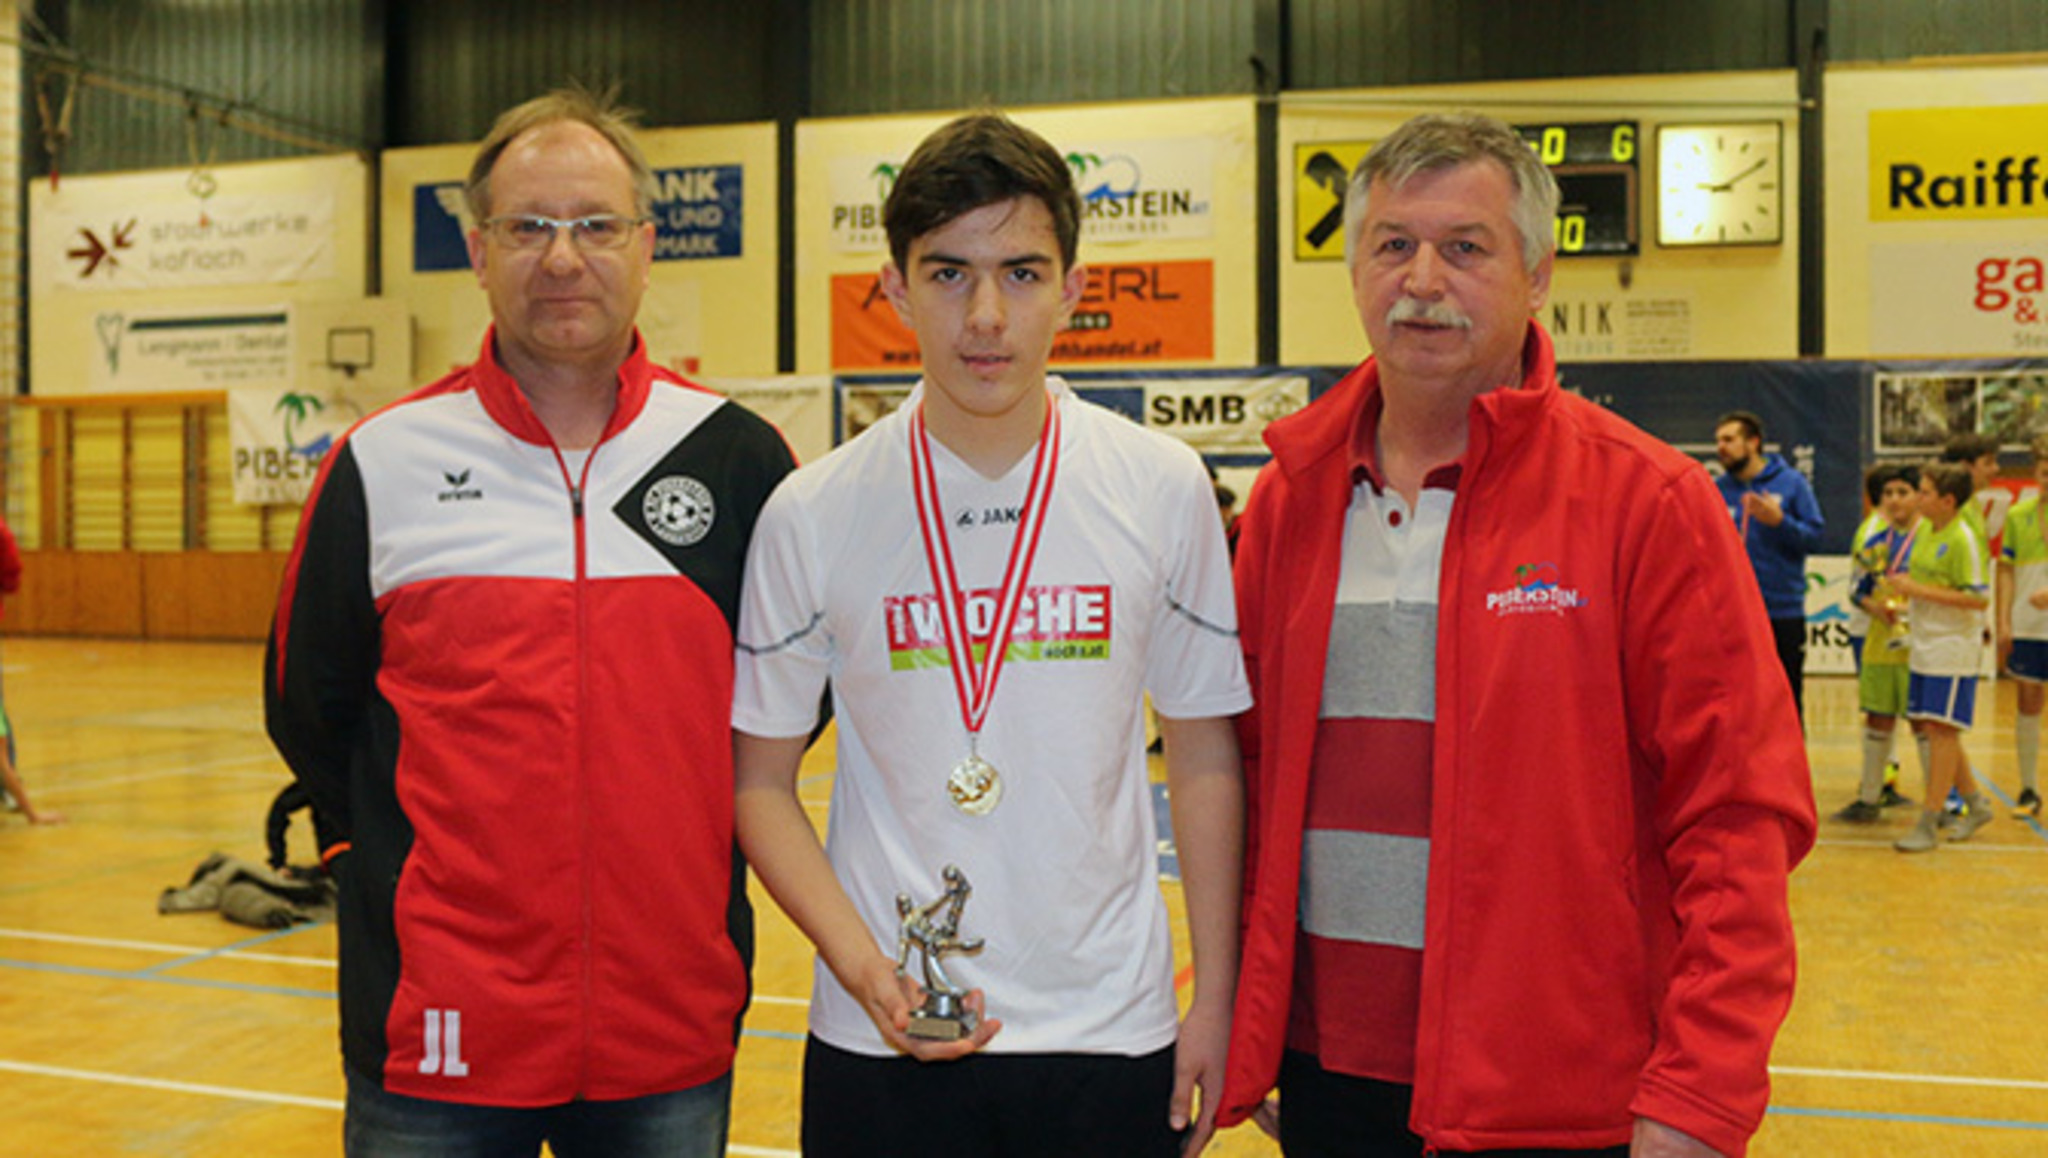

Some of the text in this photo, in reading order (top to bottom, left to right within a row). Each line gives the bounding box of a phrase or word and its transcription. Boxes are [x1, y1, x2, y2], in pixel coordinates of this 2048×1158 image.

[1889, 156, 2048, 209] Raiff
[1152, 395, 1246, 426] SMB
[908, 592, 1104, 641] WOCHE
[419, 1008, 469, 1076] JL
